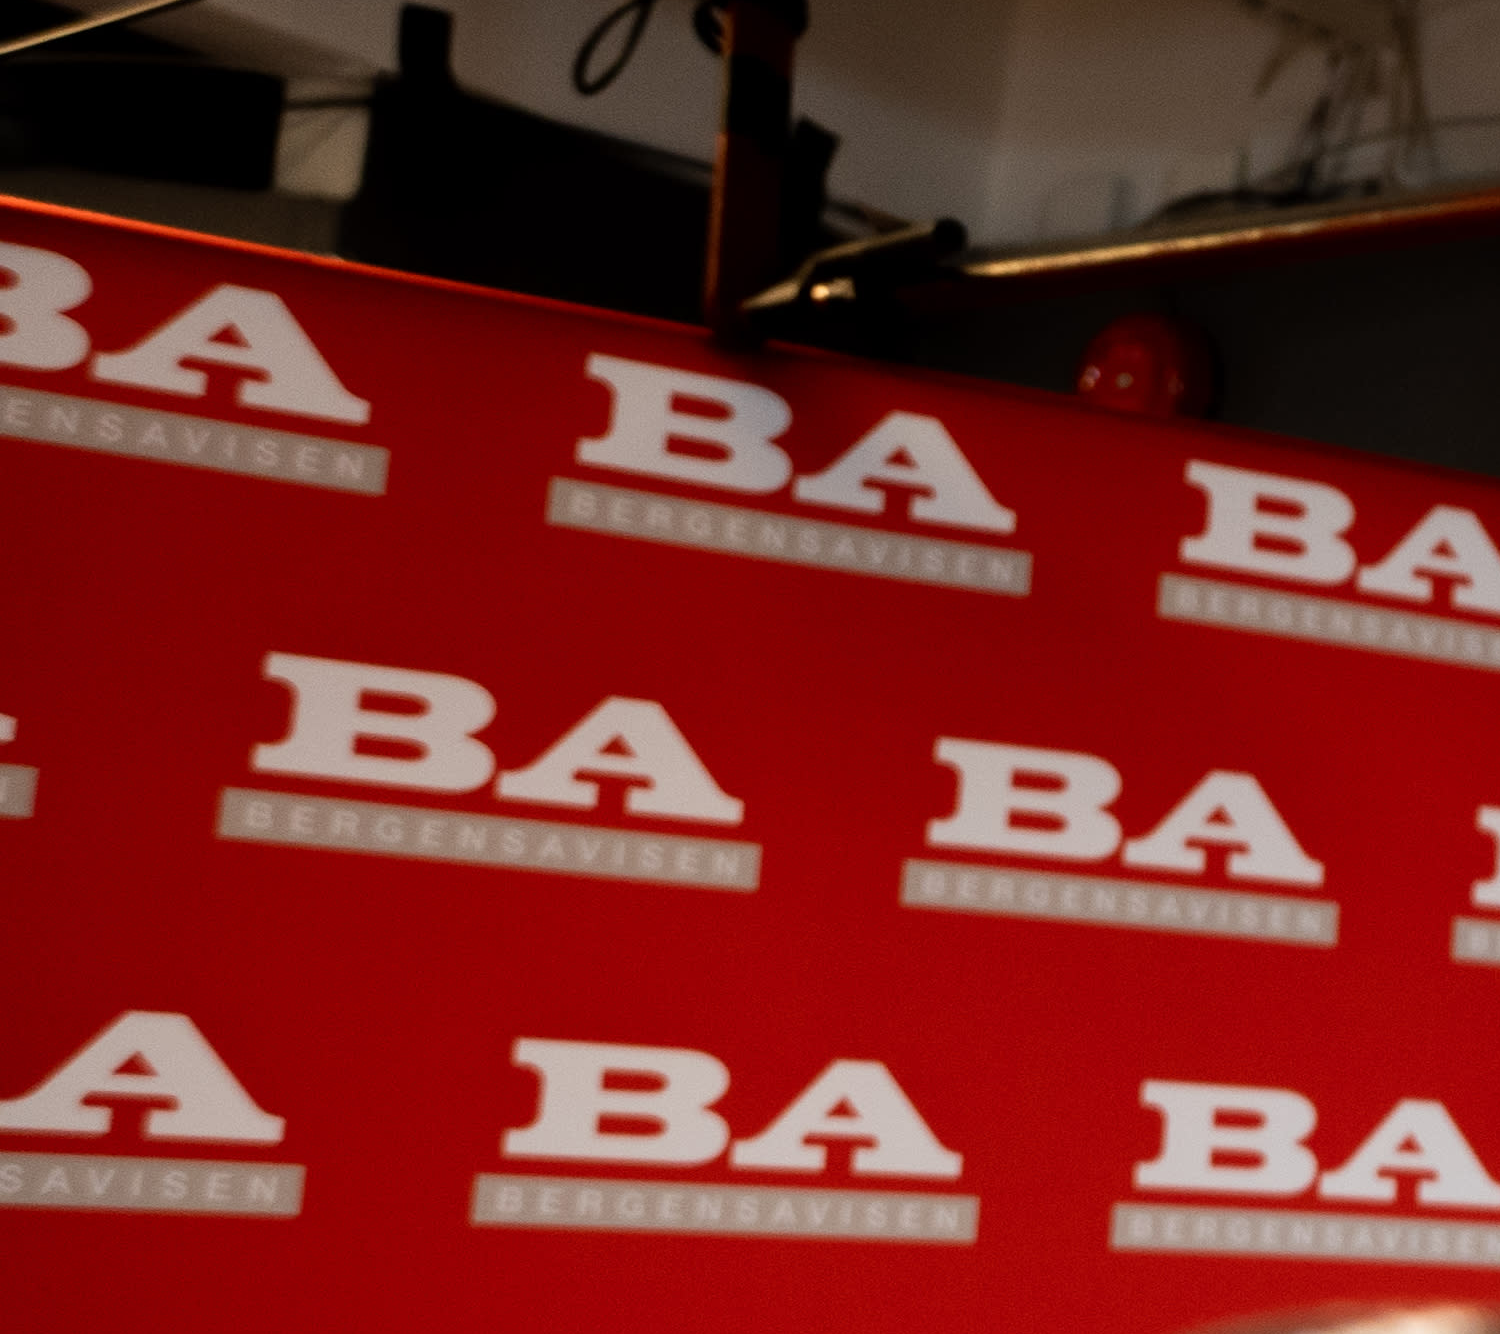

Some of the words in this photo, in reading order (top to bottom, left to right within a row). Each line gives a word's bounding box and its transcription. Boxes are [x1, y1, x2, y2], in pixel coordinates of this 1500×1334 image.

[2, 395, 366, 481] ENSAVISEN
[576, 352, 1017, 534] BA
[250, 650, 745, 826] BA
[926, 736, 1325, 886] BA
[0, 1010, 286, 1146] A
[501, 1036, 963, 1179] BA
[0, 1163, 280, 1205] SAVISEN
[495, 1184, 962, 1234] BERGENSAVISEN
